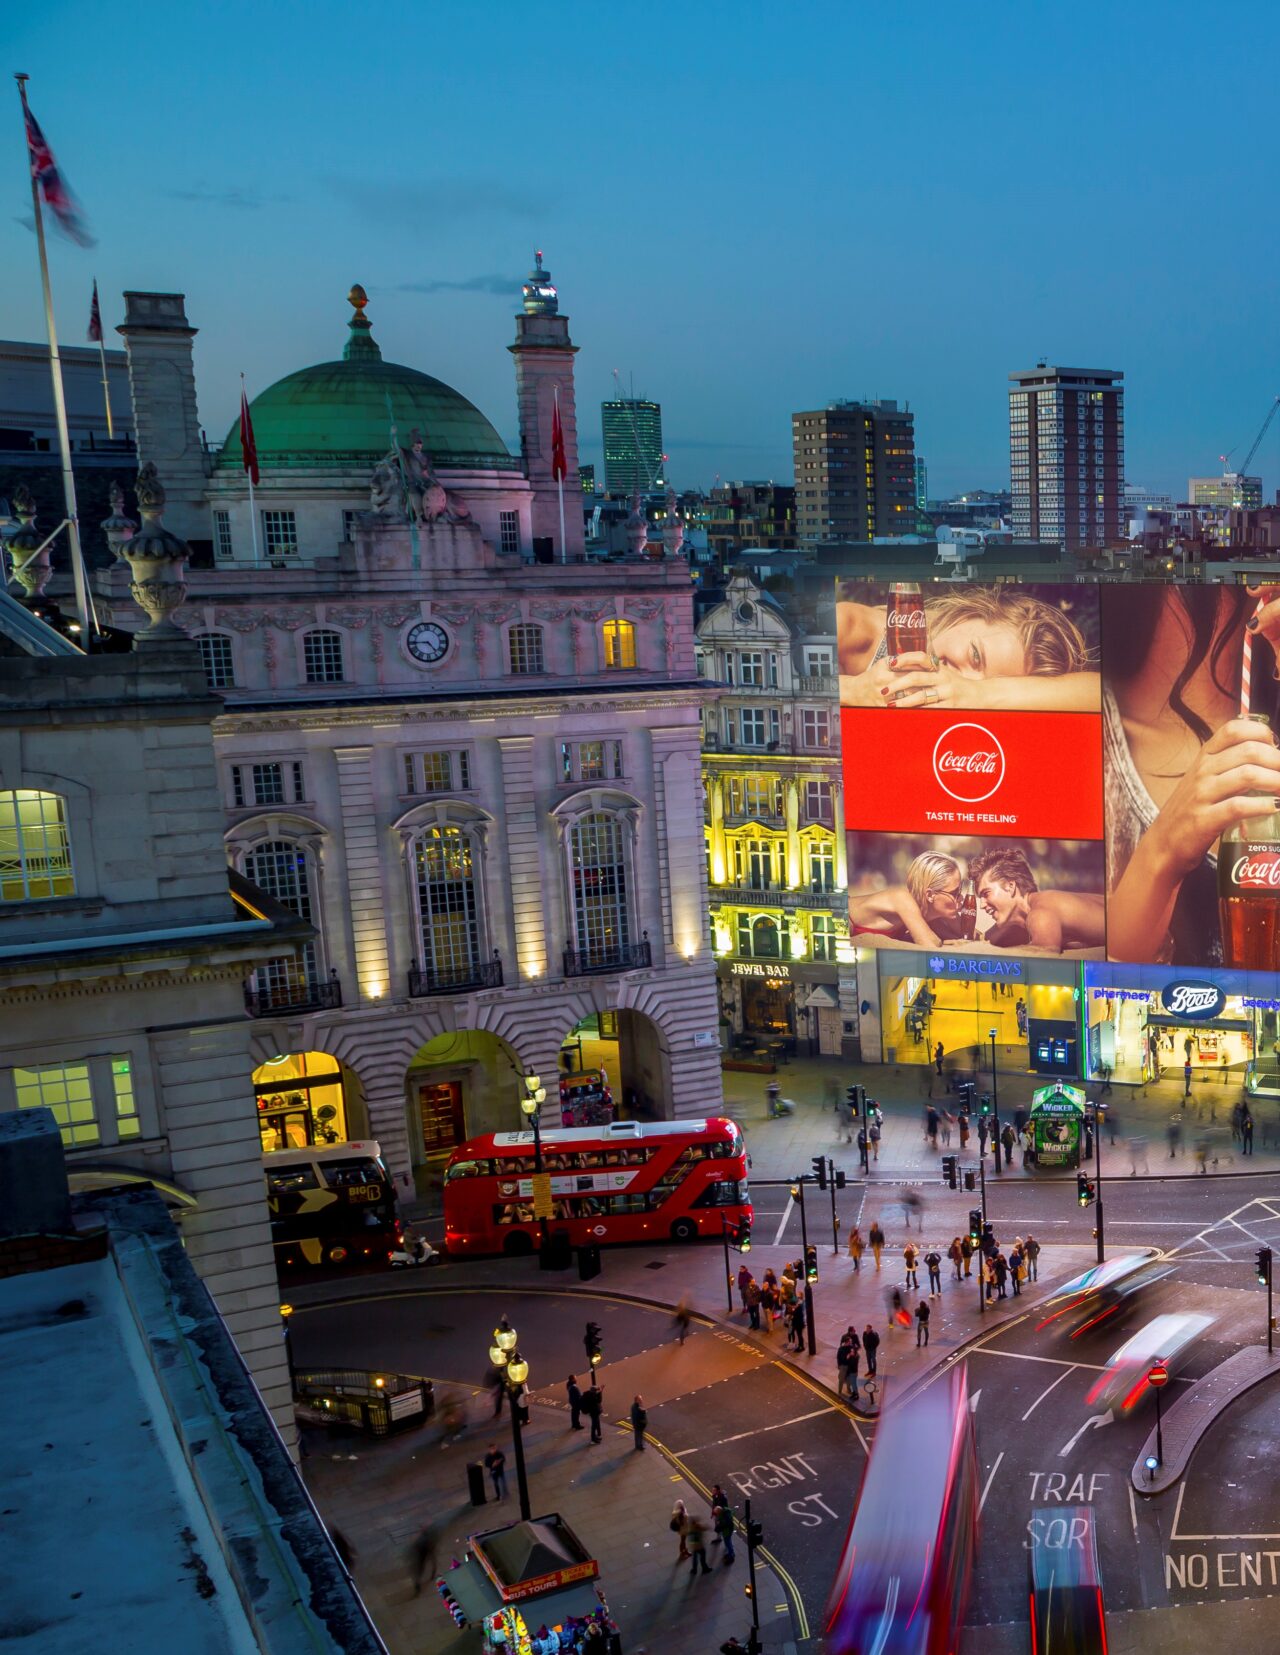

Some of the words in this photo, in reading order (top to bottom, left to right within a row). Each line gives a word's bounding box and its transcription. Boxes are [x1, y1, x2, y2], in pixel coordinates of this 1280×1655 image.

[938, 750, 998, 774] Coca-Cola
[925, 811, 955, 821] TASTE
[957, 812, 975, 822] THE
[976, 813, 1018, 824] FEELING
[731, 963, 765, 976] JEWEL
[766, 965, 790, 977] BAR
[948, 958, 1022, 977] BARCLAYS
[1094, 988, 1151, 1002] pharmacy
[1167, 986, 1218, 1014] Boots
[1042, 1103, 1073, 1111] WICKED
[1043, 1142, 1072, 1152] WICKED
[349, 1186, 366, 1196] BIG
[727, 1452, 820, 1497] RGNT
[1028, 1472, 1109, 1501] TRAF
[787, 1492, 839, 1527] ST
[1022, 1516, 1090, 1550] SQR
[1166, 1552, 1209, 1590] NO
[509, 1590, 527, 1601] BUS
[528, 1580, 558, 1594] TOURS
